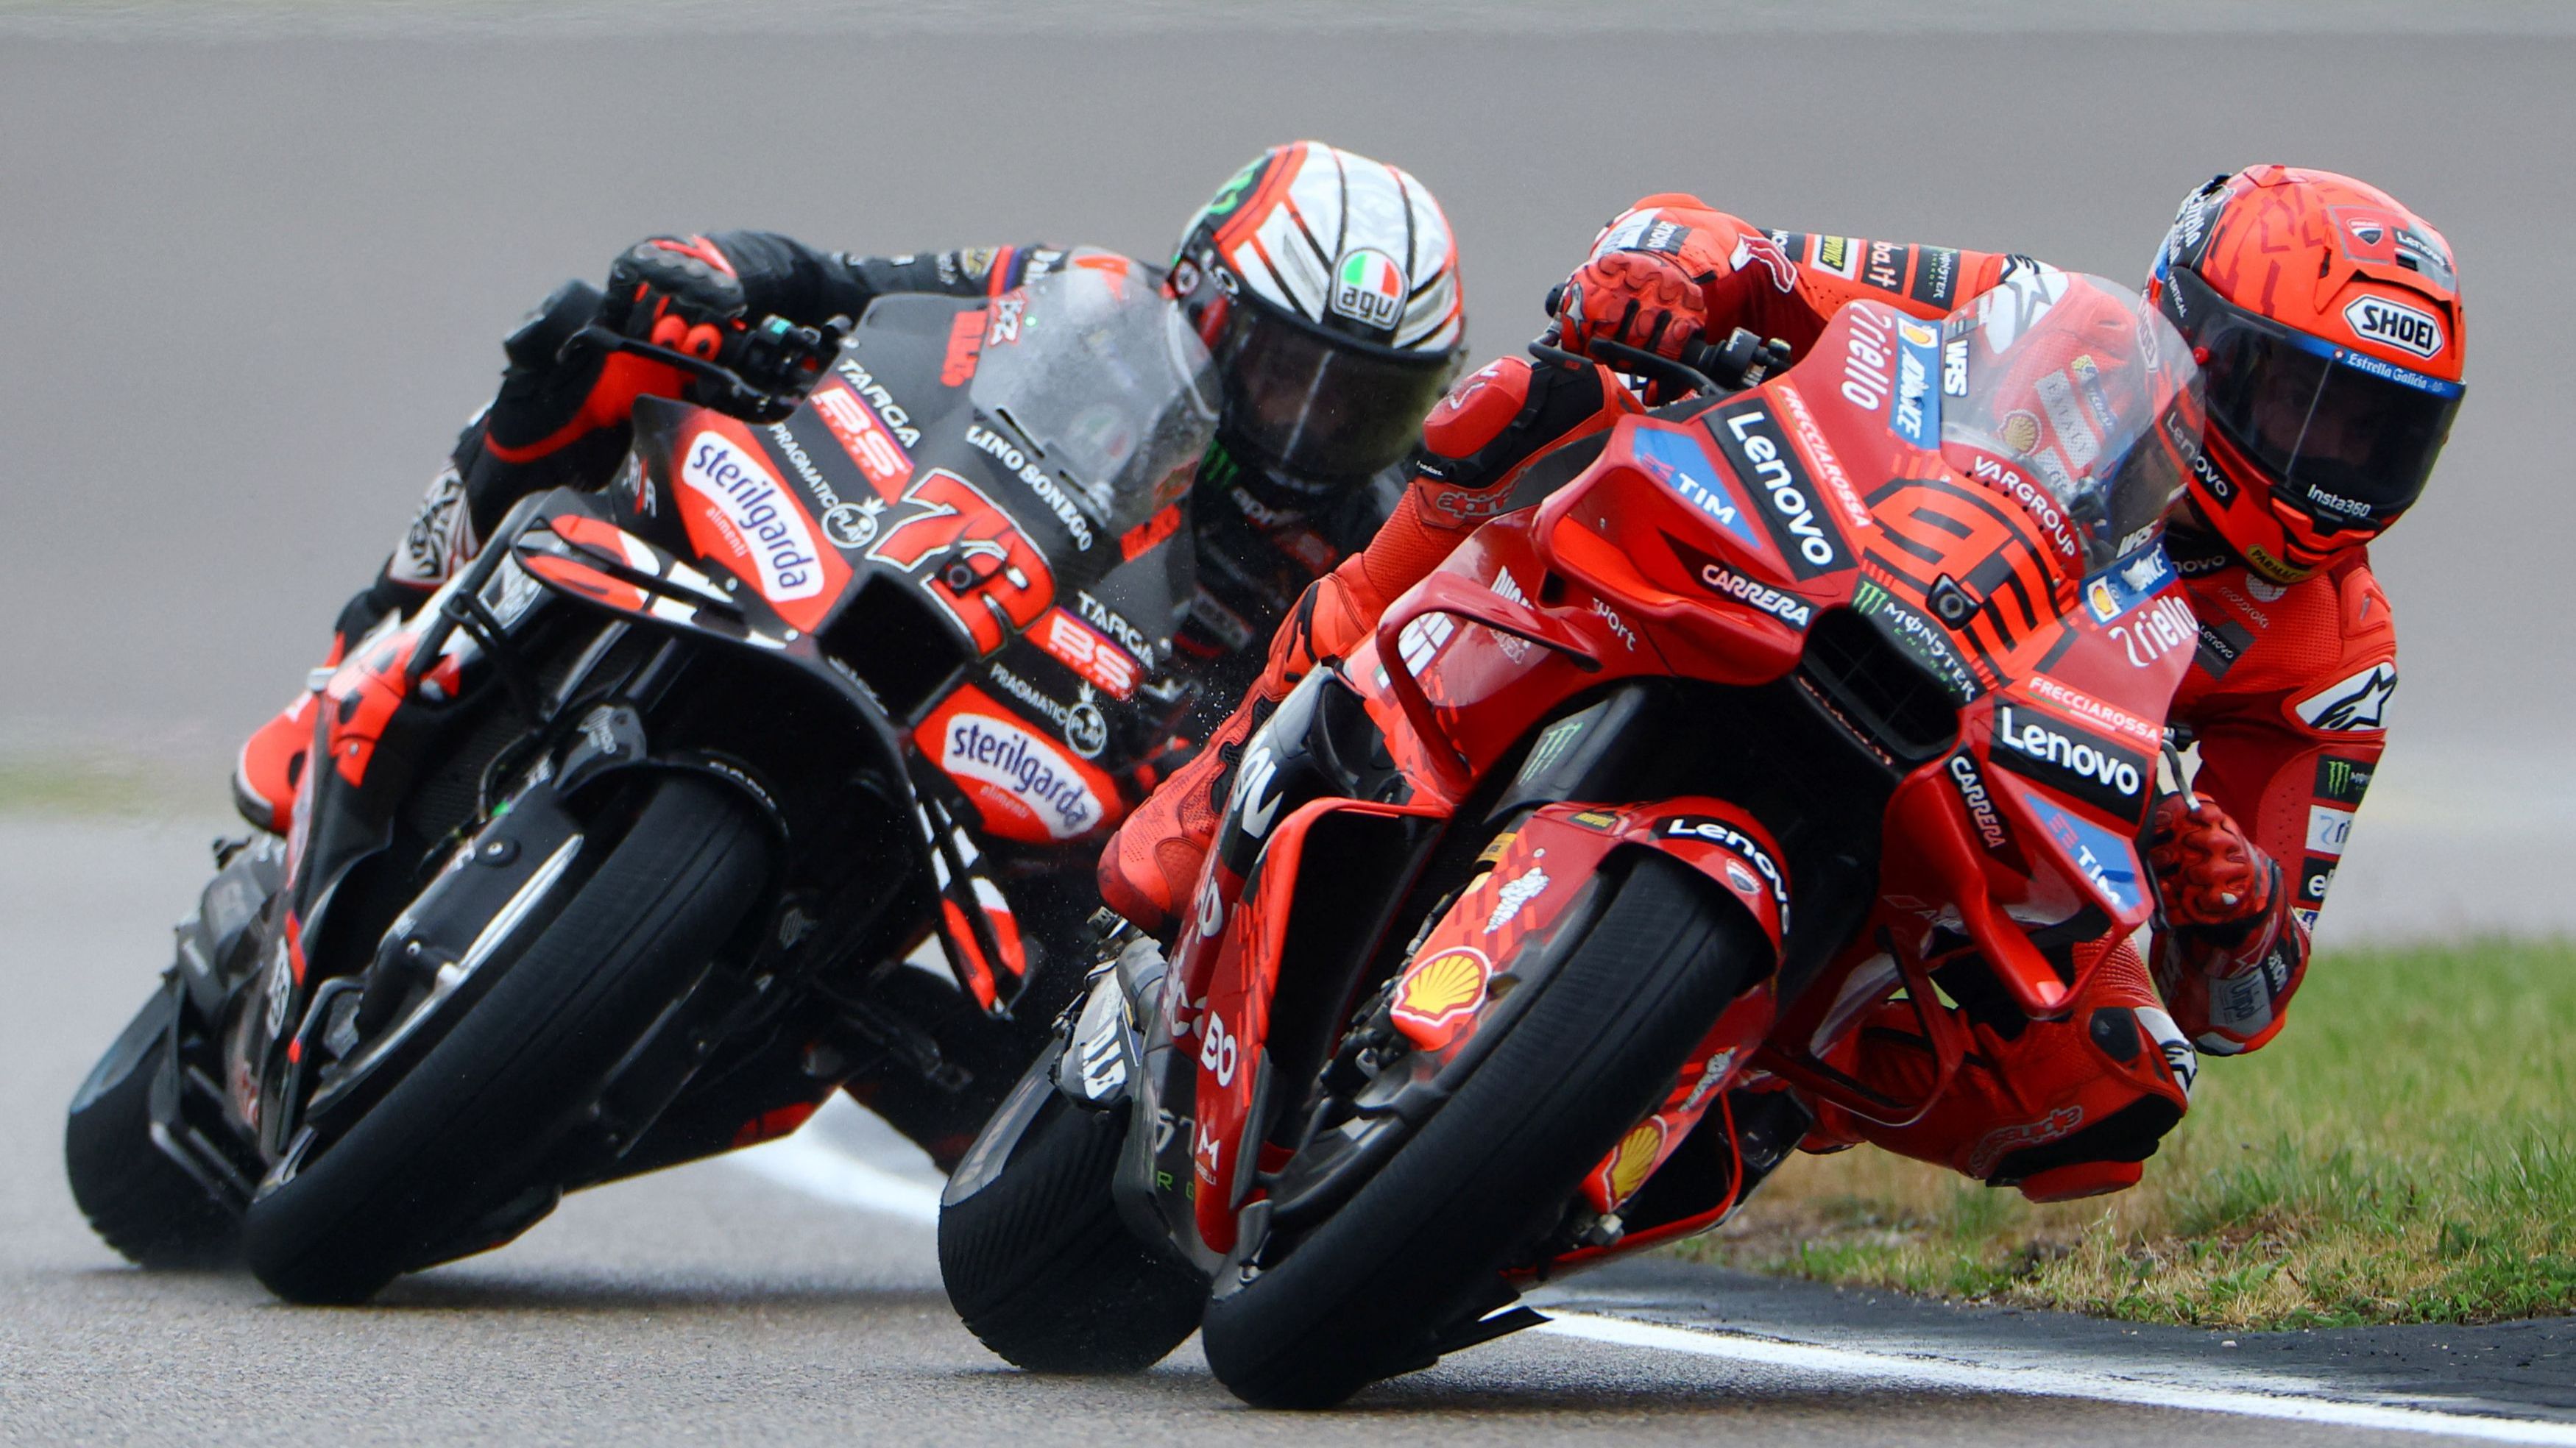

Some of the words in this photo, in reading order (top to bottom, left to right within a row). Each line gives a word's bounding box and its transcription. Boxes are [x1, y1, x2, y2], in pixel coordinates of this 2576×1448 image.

[1341, 285, 1393, 318] agv
[2168, 272, 2188, 318] VERTICAL
[2362, 304, 2434, 350] SHOEI
[1943, 339, 1968, 397] WRS
[2347, 352, 2393, 378] Estrella
[2393, 367, 2427, 389] Galicia
[817, 387, 909, 477] BS
[838, 358, 921, 448] TARGA
[768, 422, 840, 508] PRAGMATIC
[966, 425, 1025, 470] LINO
[1019, 464, 1092, 551] SONEGO
[1727, 411, 1833, 566] Lenovo
[1778, 385, 1872, 528] FRECCIAROSSA
[2167, 411, 2229, 497] Lenovo
[693, 444, 814, 589] sterilgarda
[705, 506, 747, 558] alimenti
[1679, 472, 1736, 525] TIM
[2307, 483, 2371, 519] Insta360
[1702, 564, 1810, 627] CARRERA
[2171, 555, 2226, 573] novo
[1050, 615, 1135, 689] BS
[1078, 590, 1154, 670] TARGA
[1883, 603, 1975, 703] MONSTER
[1894, 628, 1956, 692] ENERGY
[2199, 625, 2234, 659] Lenovo
[990, 662, 1067, 726] PRAGMATIC
[2030, 677, 2158, 742] FRECCIAROSSA
[953, 723, 1089, 829] sterilgarda
[2001, 706, 2140, 795] Lenovo
[1950, 756, 2007, 848] CARRERA
[1668, 818, 1790, 935] Lenovo
[2078, 845, 2122, 905] TIM
